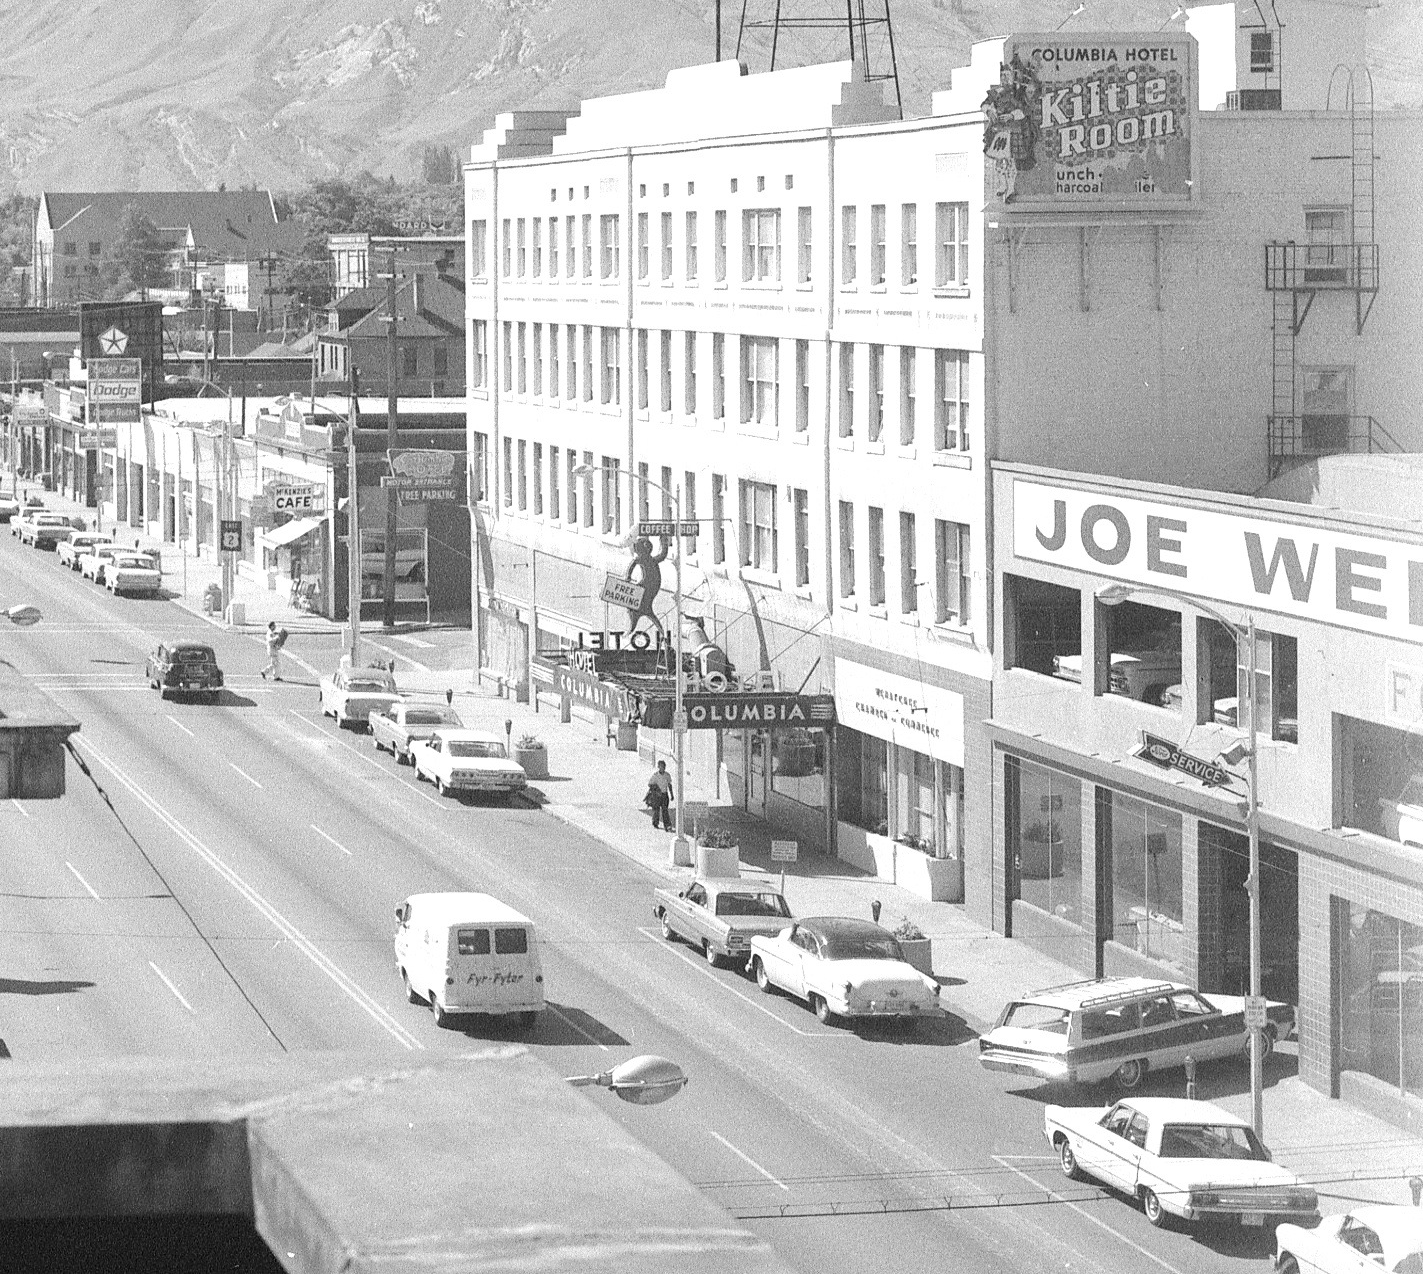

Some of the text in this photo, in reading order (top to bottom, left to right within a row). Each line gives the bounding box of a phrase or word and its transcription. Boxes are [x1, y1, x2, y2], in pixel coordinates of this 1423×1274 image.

[1032, 48, 1178, 62] COLUMBIA HOTEL
[1039, 71, 1167, 129] Kiltie
[1056, 168, 1095, 181] unch
[1056, 182, 1103, 193] harcoal
[93, 383, 137, 398] Dodge
[276, 496, 312, 509] CAFE
[640, 524, 699, 535] COFFEE HOP
[228, 535, 235, 545] 2
[1035, 499, 1188, 578] JOE
[614, 583, 636, 597] FREE
[605, 590, 640, 608] PARKING
[561, 674, 610, 708] COLUMBIA
[682, 703, 806, 723] OLUMBIA
[1169, 752, 1222, 783] SERVICE
